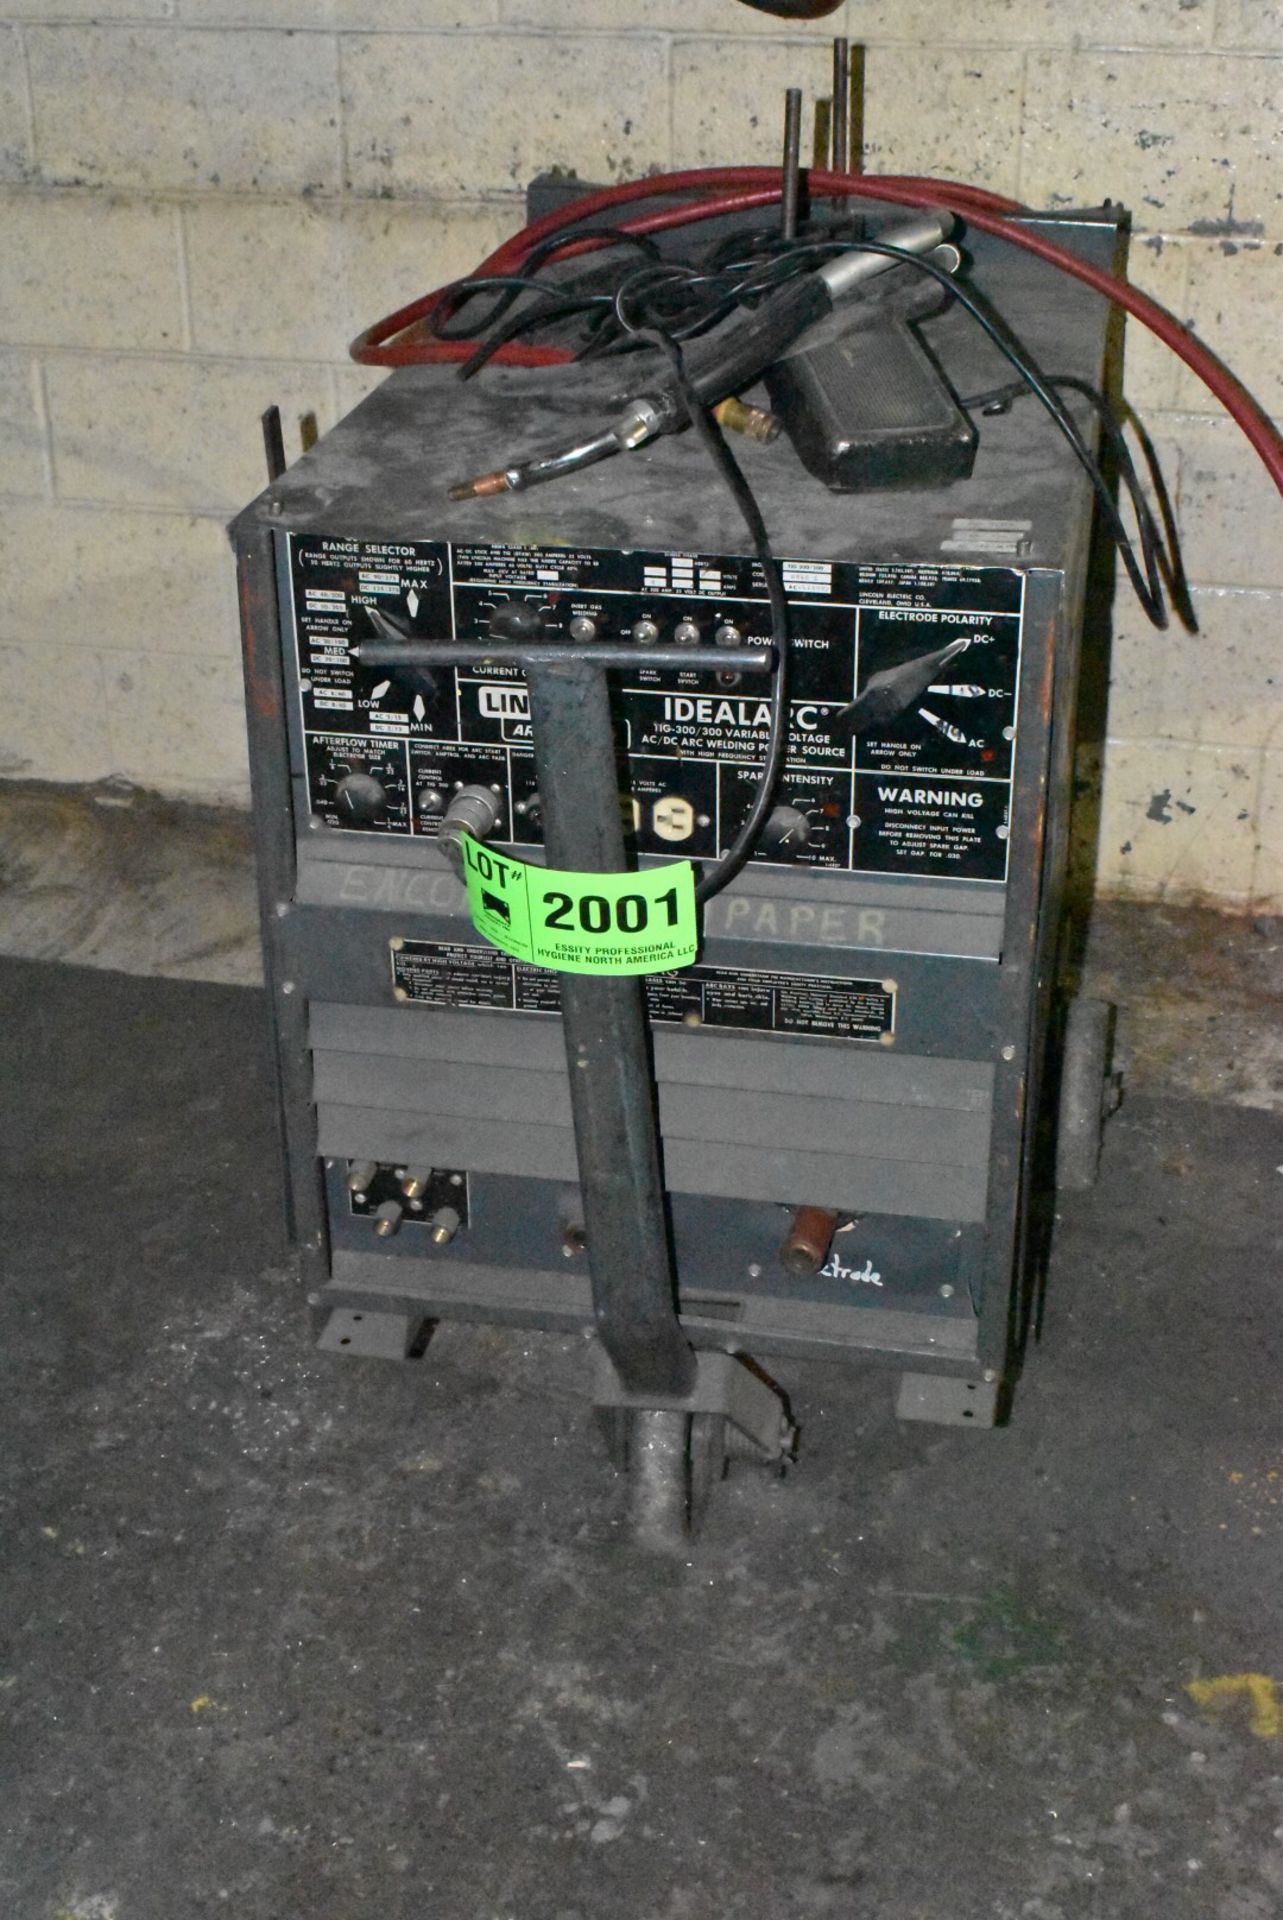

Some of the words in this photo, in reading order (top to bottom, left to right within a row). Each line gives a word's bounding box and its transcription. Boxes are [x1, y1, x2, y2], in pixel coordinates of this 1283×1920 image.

[322, 541, 359, 553] RANGE
[365, 545, 416, 557] SELECTOR
[401, 579, 428, 589] MAX
[350, 595, 378, 605] HIGH
[878, 610, 938, 622] ELECTRODE
[941, 614, 993, 626] POLARITY
[331, 625, 349, 633] ONLY
[747, 636, 775, 646] POW
[792, 638, 830, 649] WITCH
[973, 634, 996, 644] DC+
[323, 646, 346, 656] MED
[472, 666, 519, 677] CURRENT
[358, 700, 380, 709] LOW
[410, 723, 433, 732] MIN
[724, 728, 770, 741] VARIABL
[788, 733, 831, 744] OLTAGE
[312, 736, 367, 748] AFTERFLOW
[370, 740, 399, 750] TIMER
[641, 734, 679, 747] AC/DC
[681, 737, 703, 748] ARC
[706, 738, 756, 752] WELDING
[802, 746, 846, 758] SOURCE
[881, 742, 908, 750] HANDLE
[968, 739, 985, 748] AC
[718, 752, 756, 761] FREQUENCY
[870, 749, 895, 757] ARROW
[898, 750, 917, 758] ONLY
[911, 766, 938, 774] SWITCH
[966, 769, 985, 777] LOAD
[737, 770, 764, 782] SPAR
[782, 774, 834, 786] NTENSITY
[877, 786, 984, 808] WARNING
[907, 809, 940, 817] VOLTAGE
[884, 822, 927, 831] DISCONNECT
[952, 826, 976, 834] POWER
[905, 832, 942, 841] REMOVING
[962, 836, 982, 844] PLATE
[901, 840, 926, 848] ADJUST
[929, 842, 951, 850] SPARK
[543, 887, 679, 934] 2001
[724, 896, 886, 945] PAPER
[537, 948, 582, 963] HYGIENE
[585, 954, 622, 965] NORTH
[626, 952, 674, 965] AMERICA
[677, 944, 696, 958] LLC
[555, 942, 591, 955] ESSITY
[595, 942, 676, 957] PROFESSIONAL
